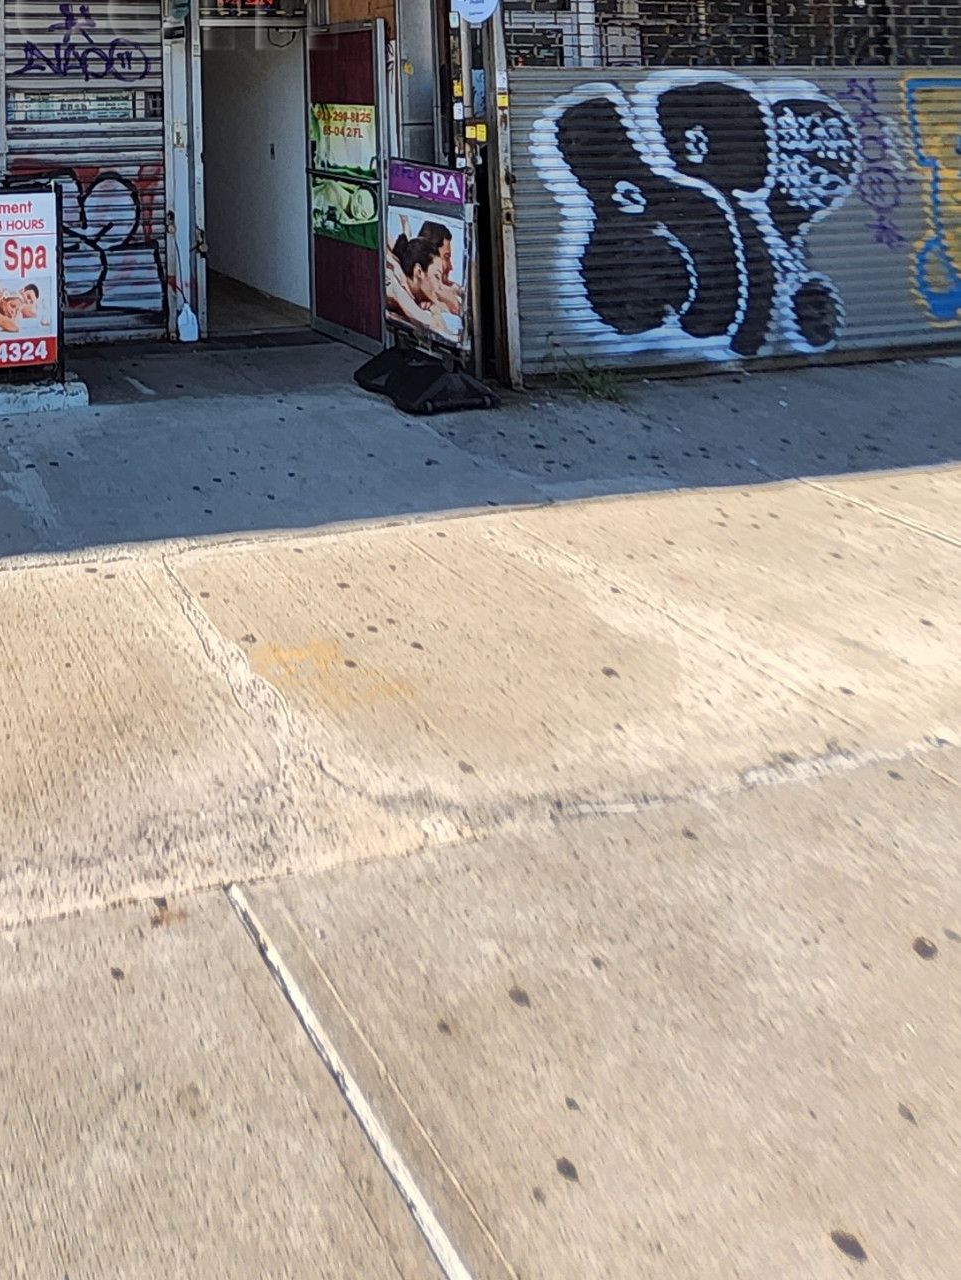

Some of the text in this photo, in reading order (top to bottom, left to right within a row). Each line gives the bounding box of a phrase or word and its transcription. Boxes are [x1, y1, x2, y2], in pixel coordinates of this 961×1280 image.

[419, 170, 461, 199] SPA
[6, 219, 45, 231] HOURS
[4, 238, 47, 278] Spa
